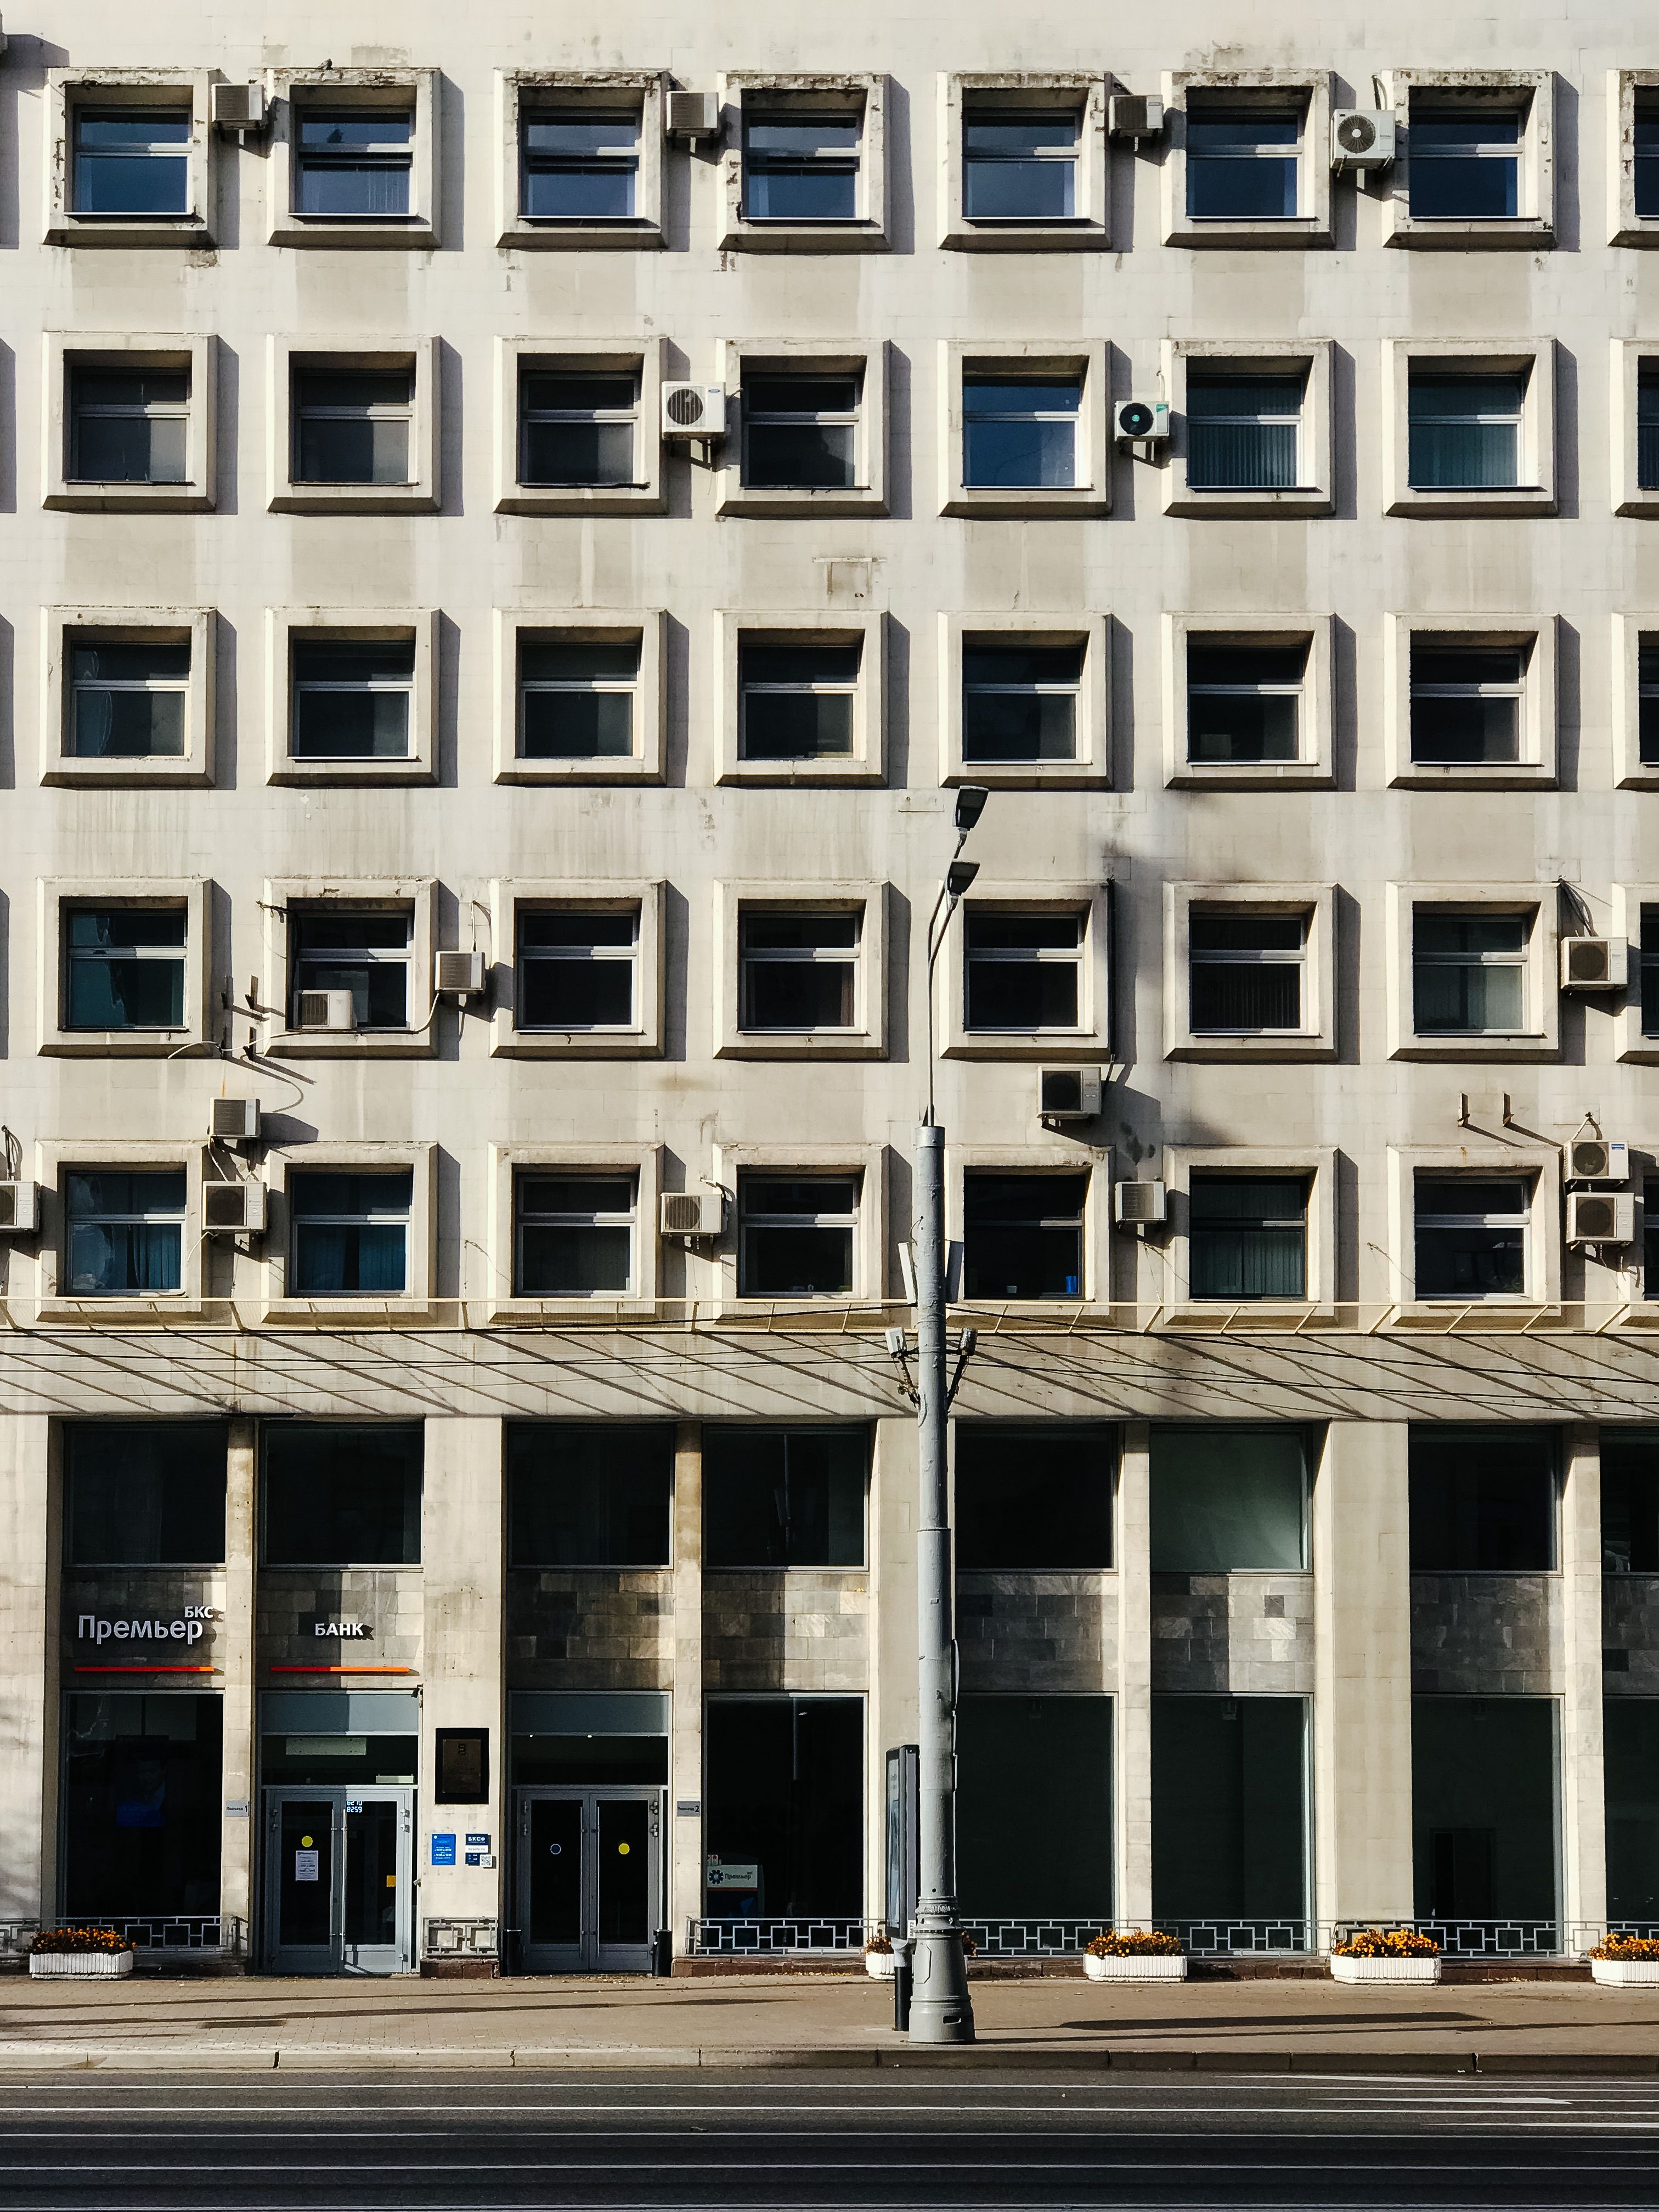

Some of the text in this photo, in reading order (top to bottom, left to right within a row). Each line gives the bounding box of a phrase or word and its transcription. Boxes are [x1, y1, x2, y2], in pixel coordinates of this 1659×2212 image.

[185, 1606, 213, 1618] БКС
[78, 1615, 203, 1645] Премьер
[315, 1623, 364, 1636] БАНК
